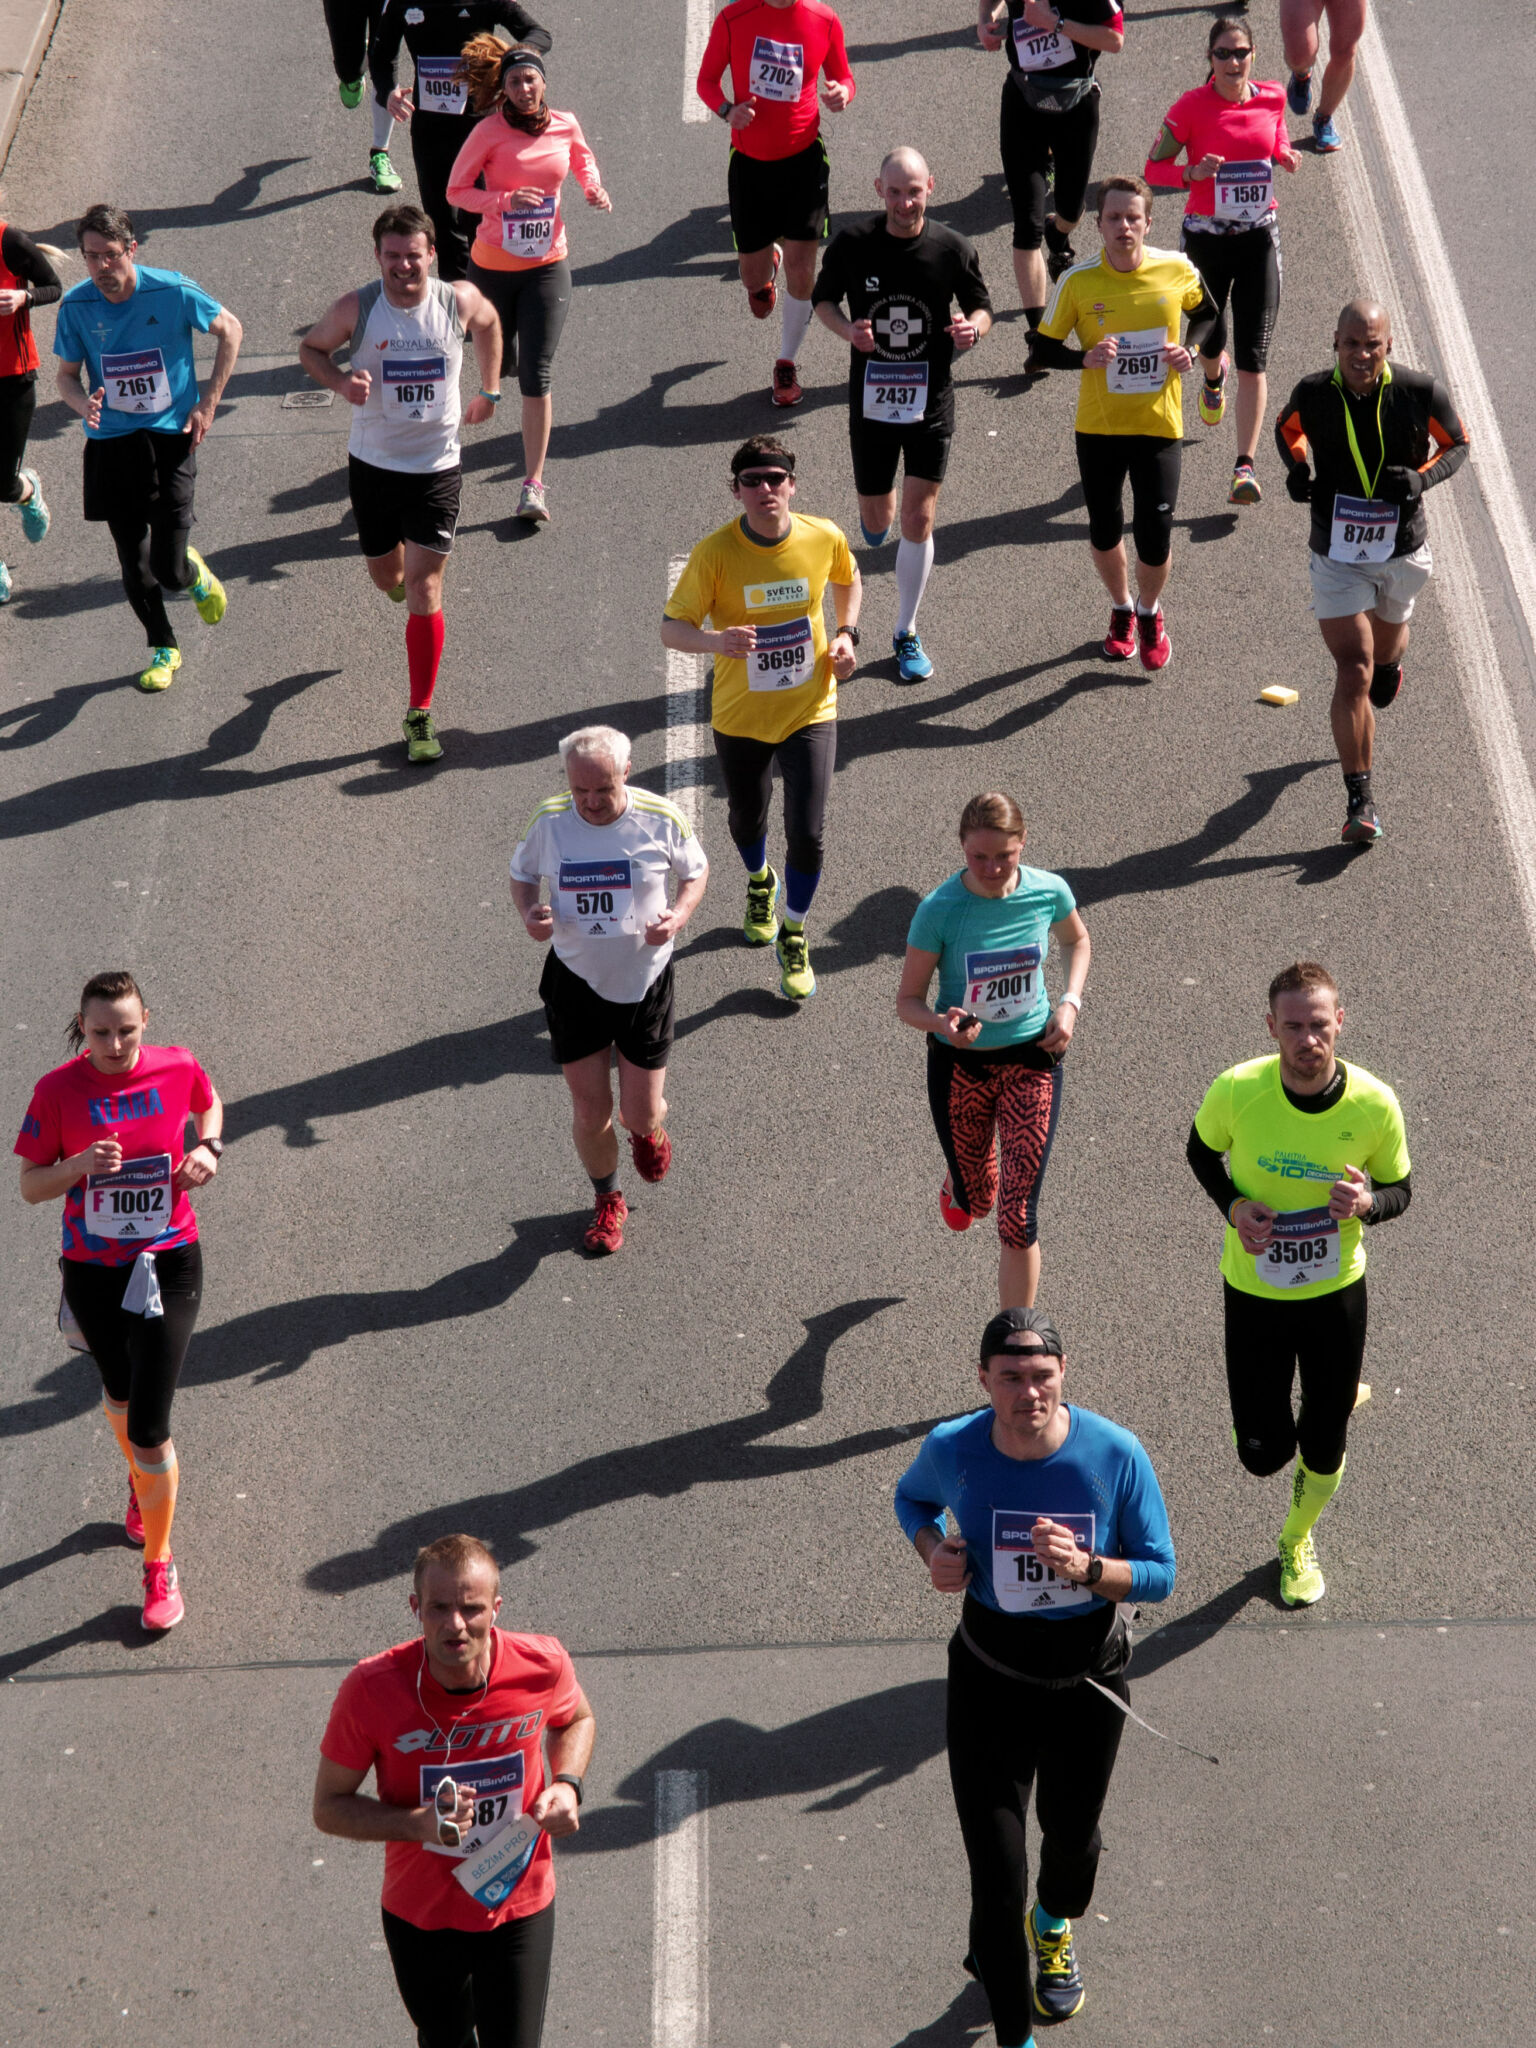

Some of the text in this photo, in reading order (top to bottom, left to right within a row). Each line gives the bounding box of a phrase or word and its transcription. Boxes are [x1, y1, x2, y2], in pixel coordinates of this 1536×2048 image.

[1027, 32, 1060, 56] 1723
[759, 63, 795, 86] 2702
[425, 80, 461, 97] 4094
[1221, 184, 1267, 204] F 1587
[508, 220, 551, 240] F 1603
[390, 339, 424, 349] ROYAL
[1117, 354, 1159, 376] 2697
[116, 375, 156, 397] 2161
[394, 383, 436, 403] 1676
[875, 386, 917, 405] 2437
[1343, 523, 1386, 545] 8744
[757, 645, 806, 671] 3699
[576, 891, 614, 915] 570
[971, 972, 1032, 1003] F 2001
[1281, 1166, 1305, 1179] 10
[93, 1187, 164, 1214] F 1002
[1268, 1238, 1328, 1264] 3503
[425, 1708, 543, 1752] LOTTO
[503, 1829, 528, 1852] PRO
